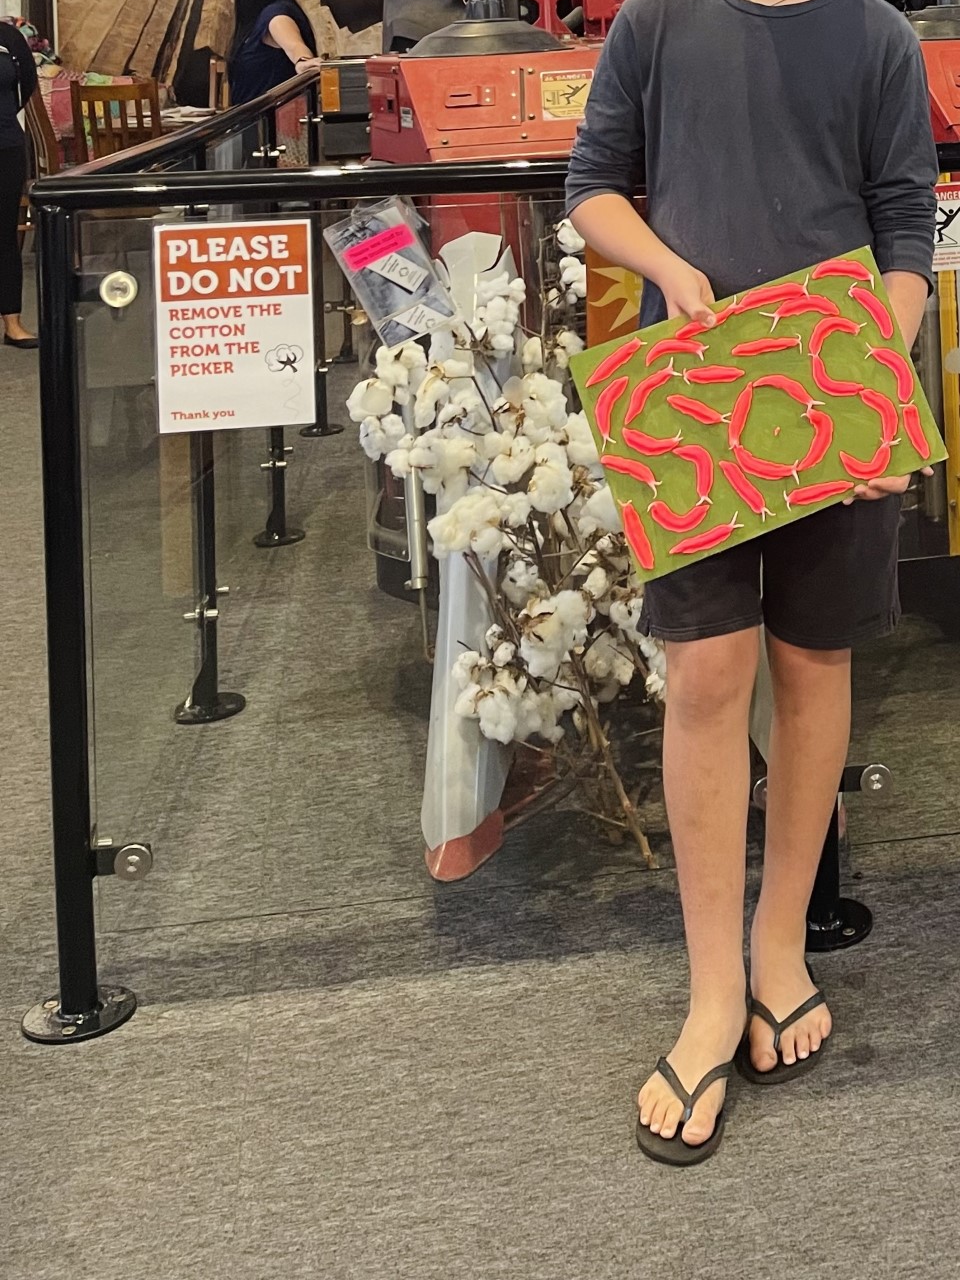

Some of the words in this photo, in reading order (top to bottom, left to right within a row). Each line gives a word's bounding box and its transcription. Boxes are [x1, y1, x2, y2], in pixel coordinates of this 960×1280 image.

[166, 234, 289, 265] PLEASE
[167, 269, 219, 296] DO
[227, 265, 303, 294] NOT
[168, 305, 242, 322] REMOVE
[246, 303, 283, 317] THE
[169, 323, 246, 340] COTTON
[169, 343, 220, 359] FROM
[223, 341, 260, 355] THE
[170, 361, 234, 377] PICKER
[171, 410, 210, 421] Thank
[212, 409, 235, 420] you
